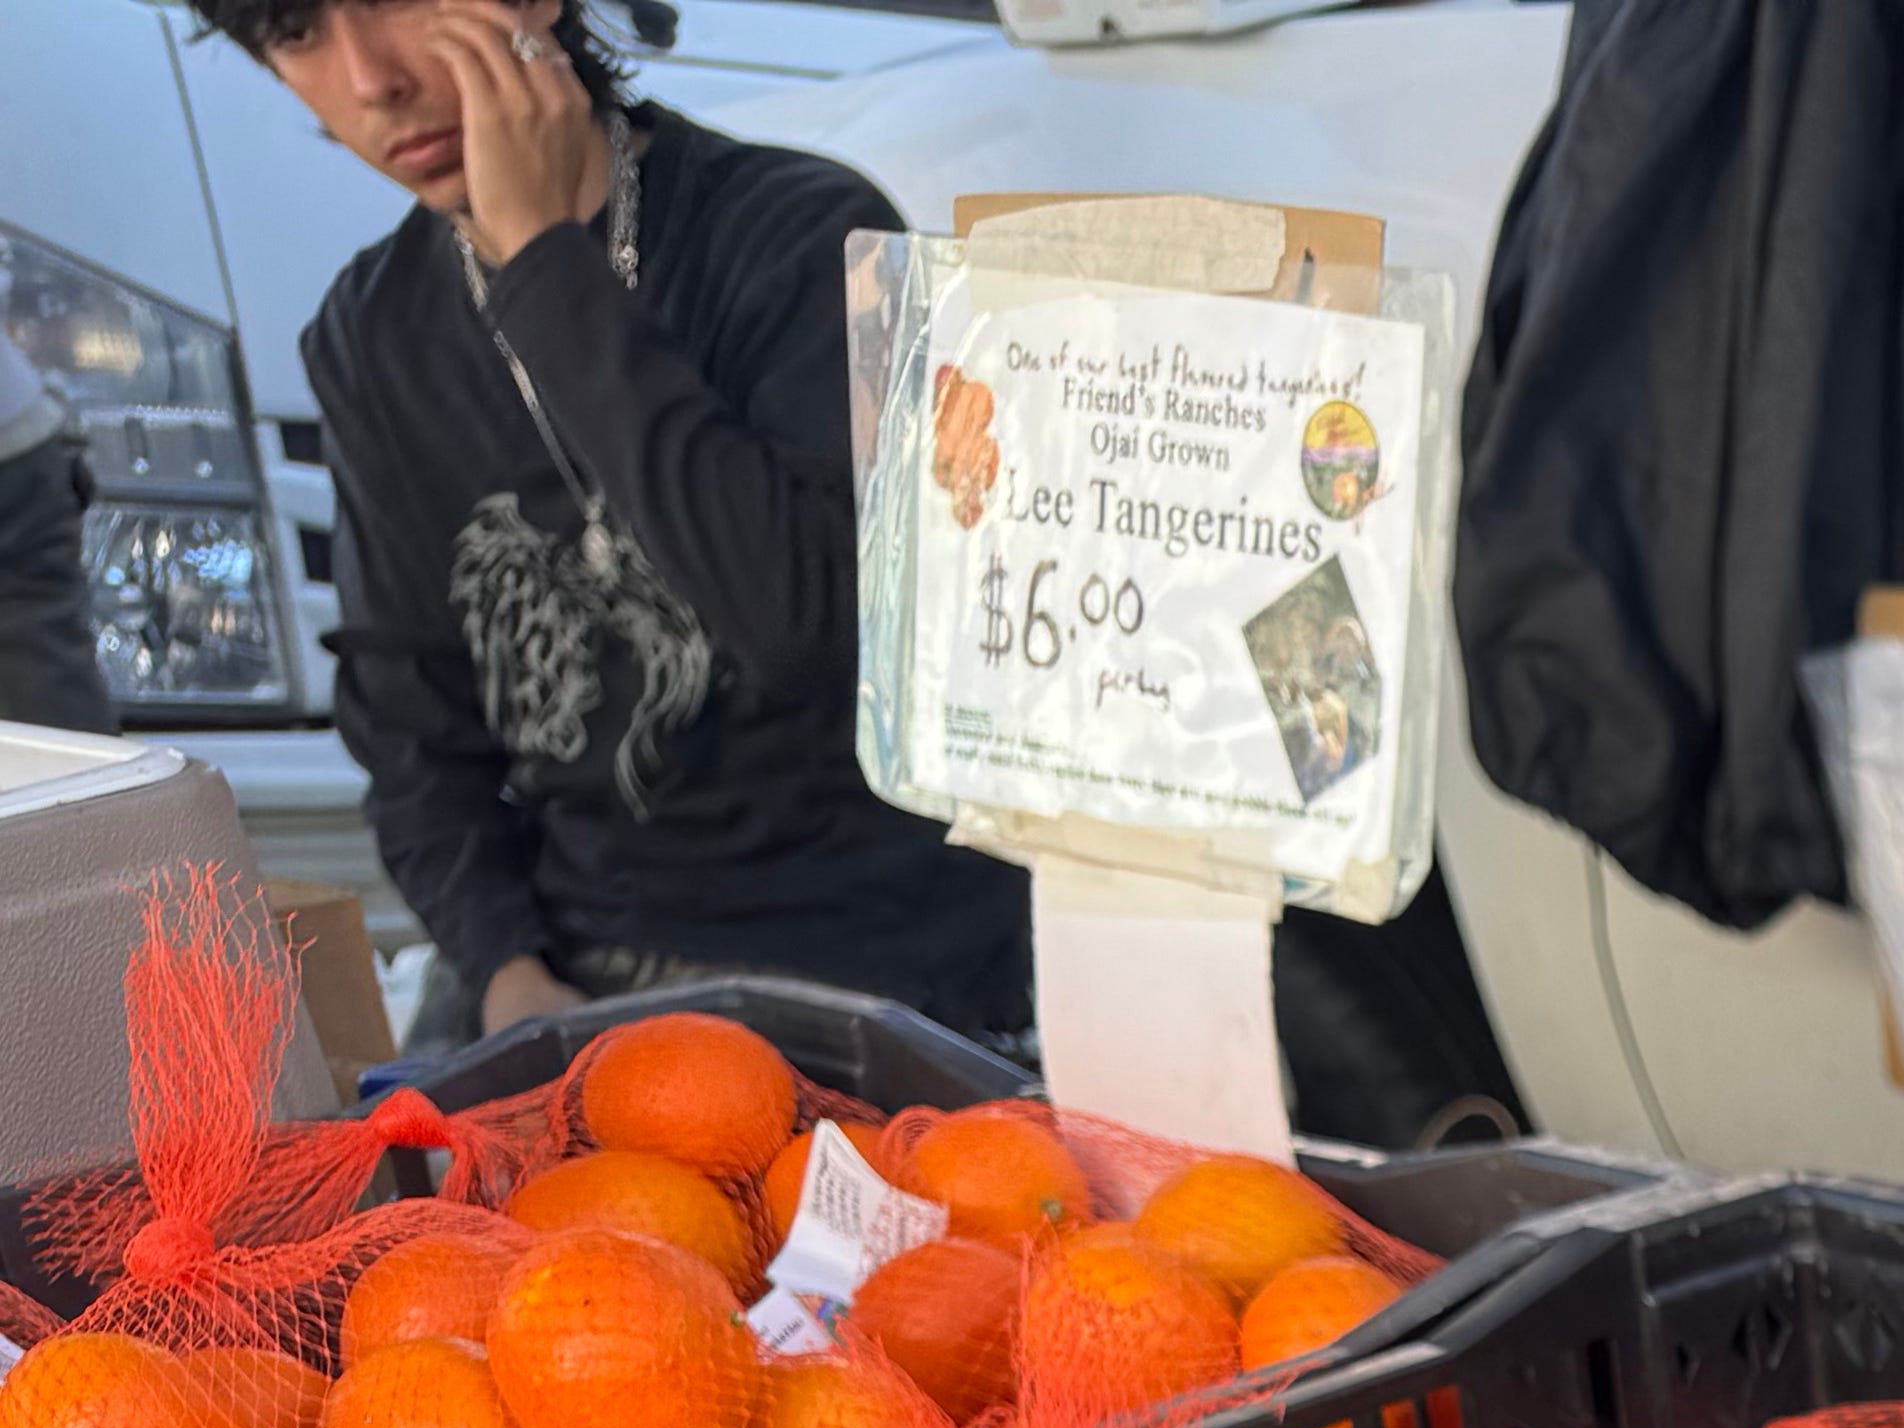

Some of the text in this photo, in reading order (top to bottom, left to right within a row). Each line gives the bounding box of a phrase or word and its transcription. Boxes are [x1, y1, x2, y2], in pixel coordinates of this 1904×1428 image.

[1062, 377, 1155, 416] Friend's
[1163, 389, 1267, 432] Ranches
[1090, 422, 1231, 472] Ojai Grown
[1004, 467, 1323, 563] Lee Tangerines
[979, 551, 1144, 670] $6.00
